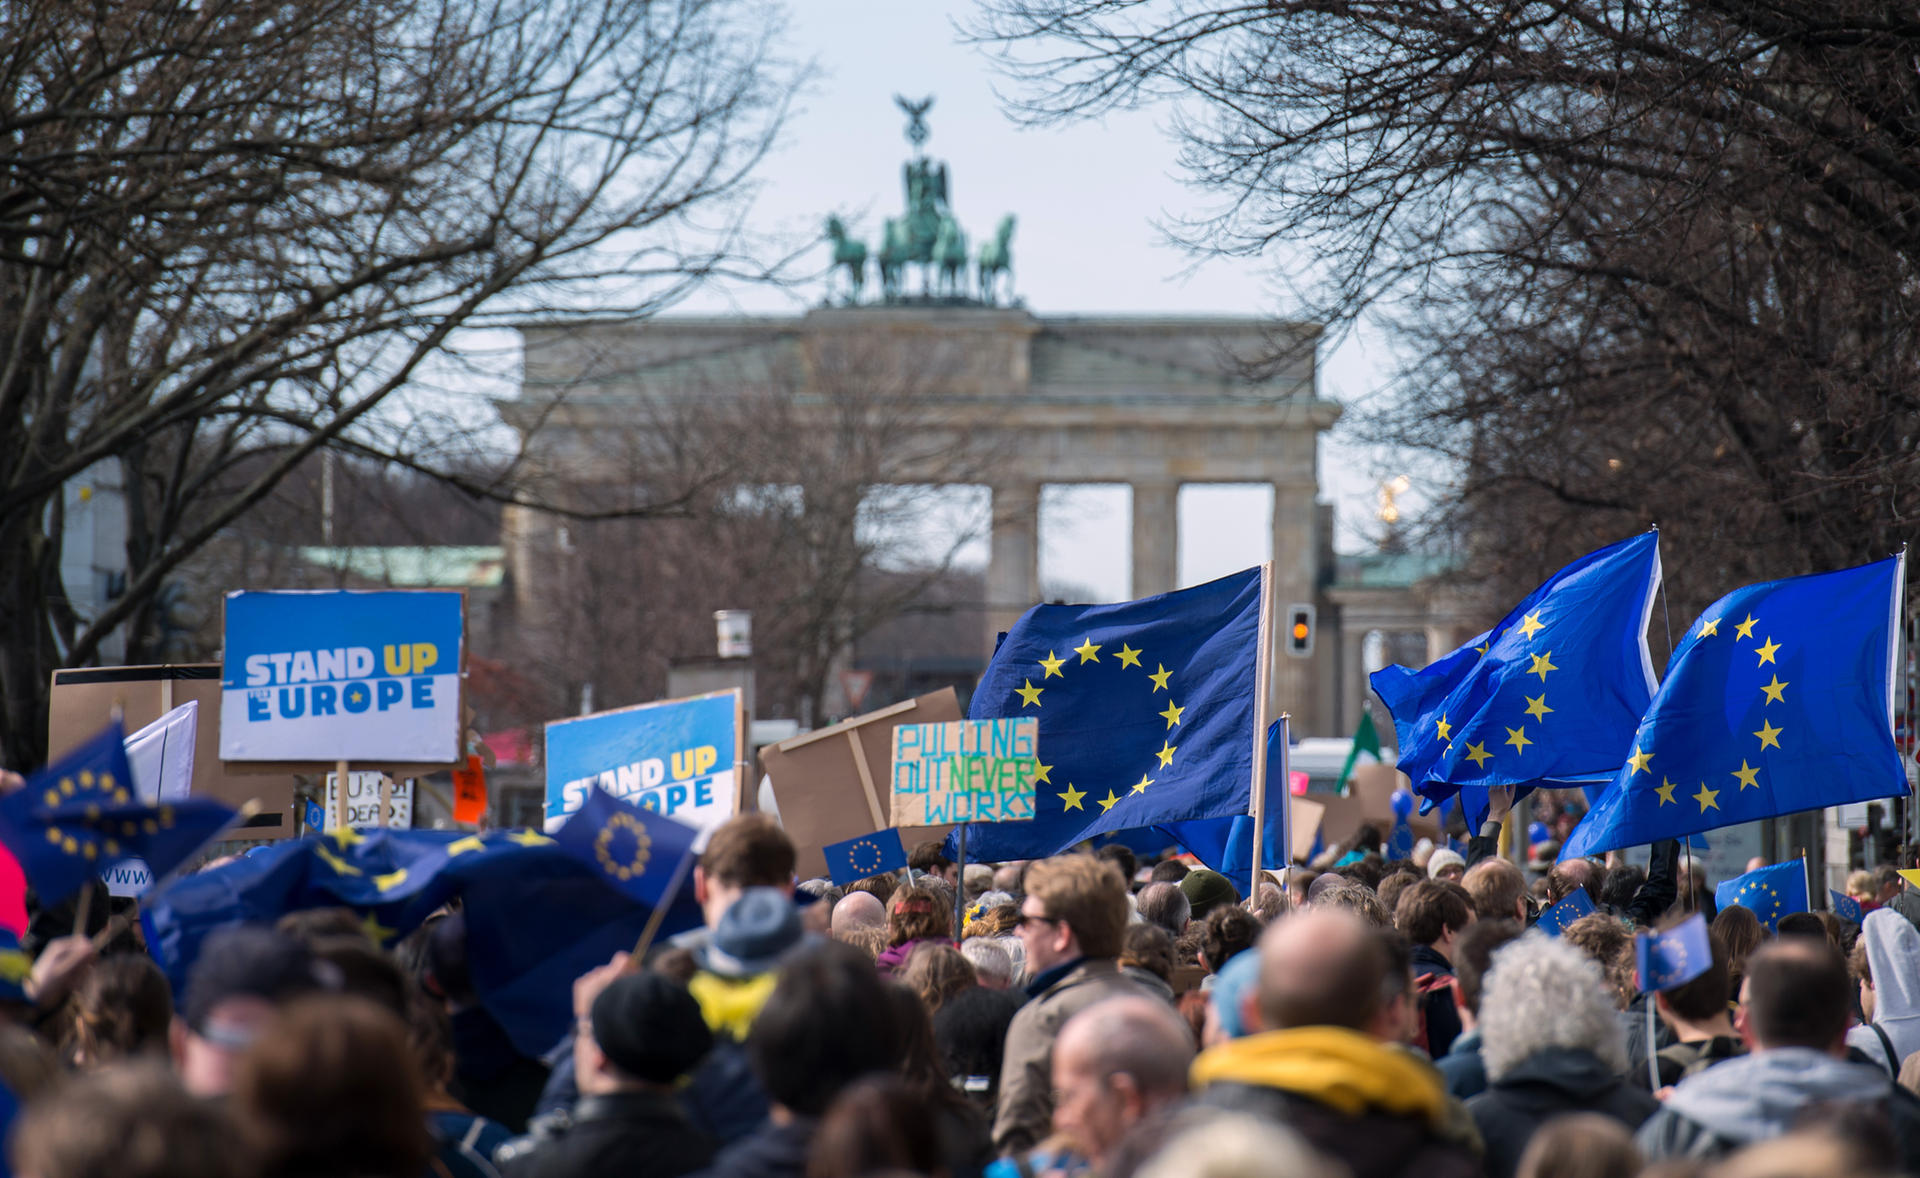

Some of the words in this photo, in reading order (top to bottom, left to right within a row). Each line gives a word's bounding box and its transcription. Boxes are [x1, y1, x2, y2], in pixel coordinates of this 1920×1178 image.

[245, 647, 375, 687] STAND
[384, 642, 439, 676] UP
[248, 677, 436, 722] EUROPE
[897, 716, 1035, 760] PULLING
[671, 745, 717, 781] UP
[894, 755, 948, 795] OUT
[949, 755, 1037, 794] NEVER
[924, 790, 1037, 826] WORKS
